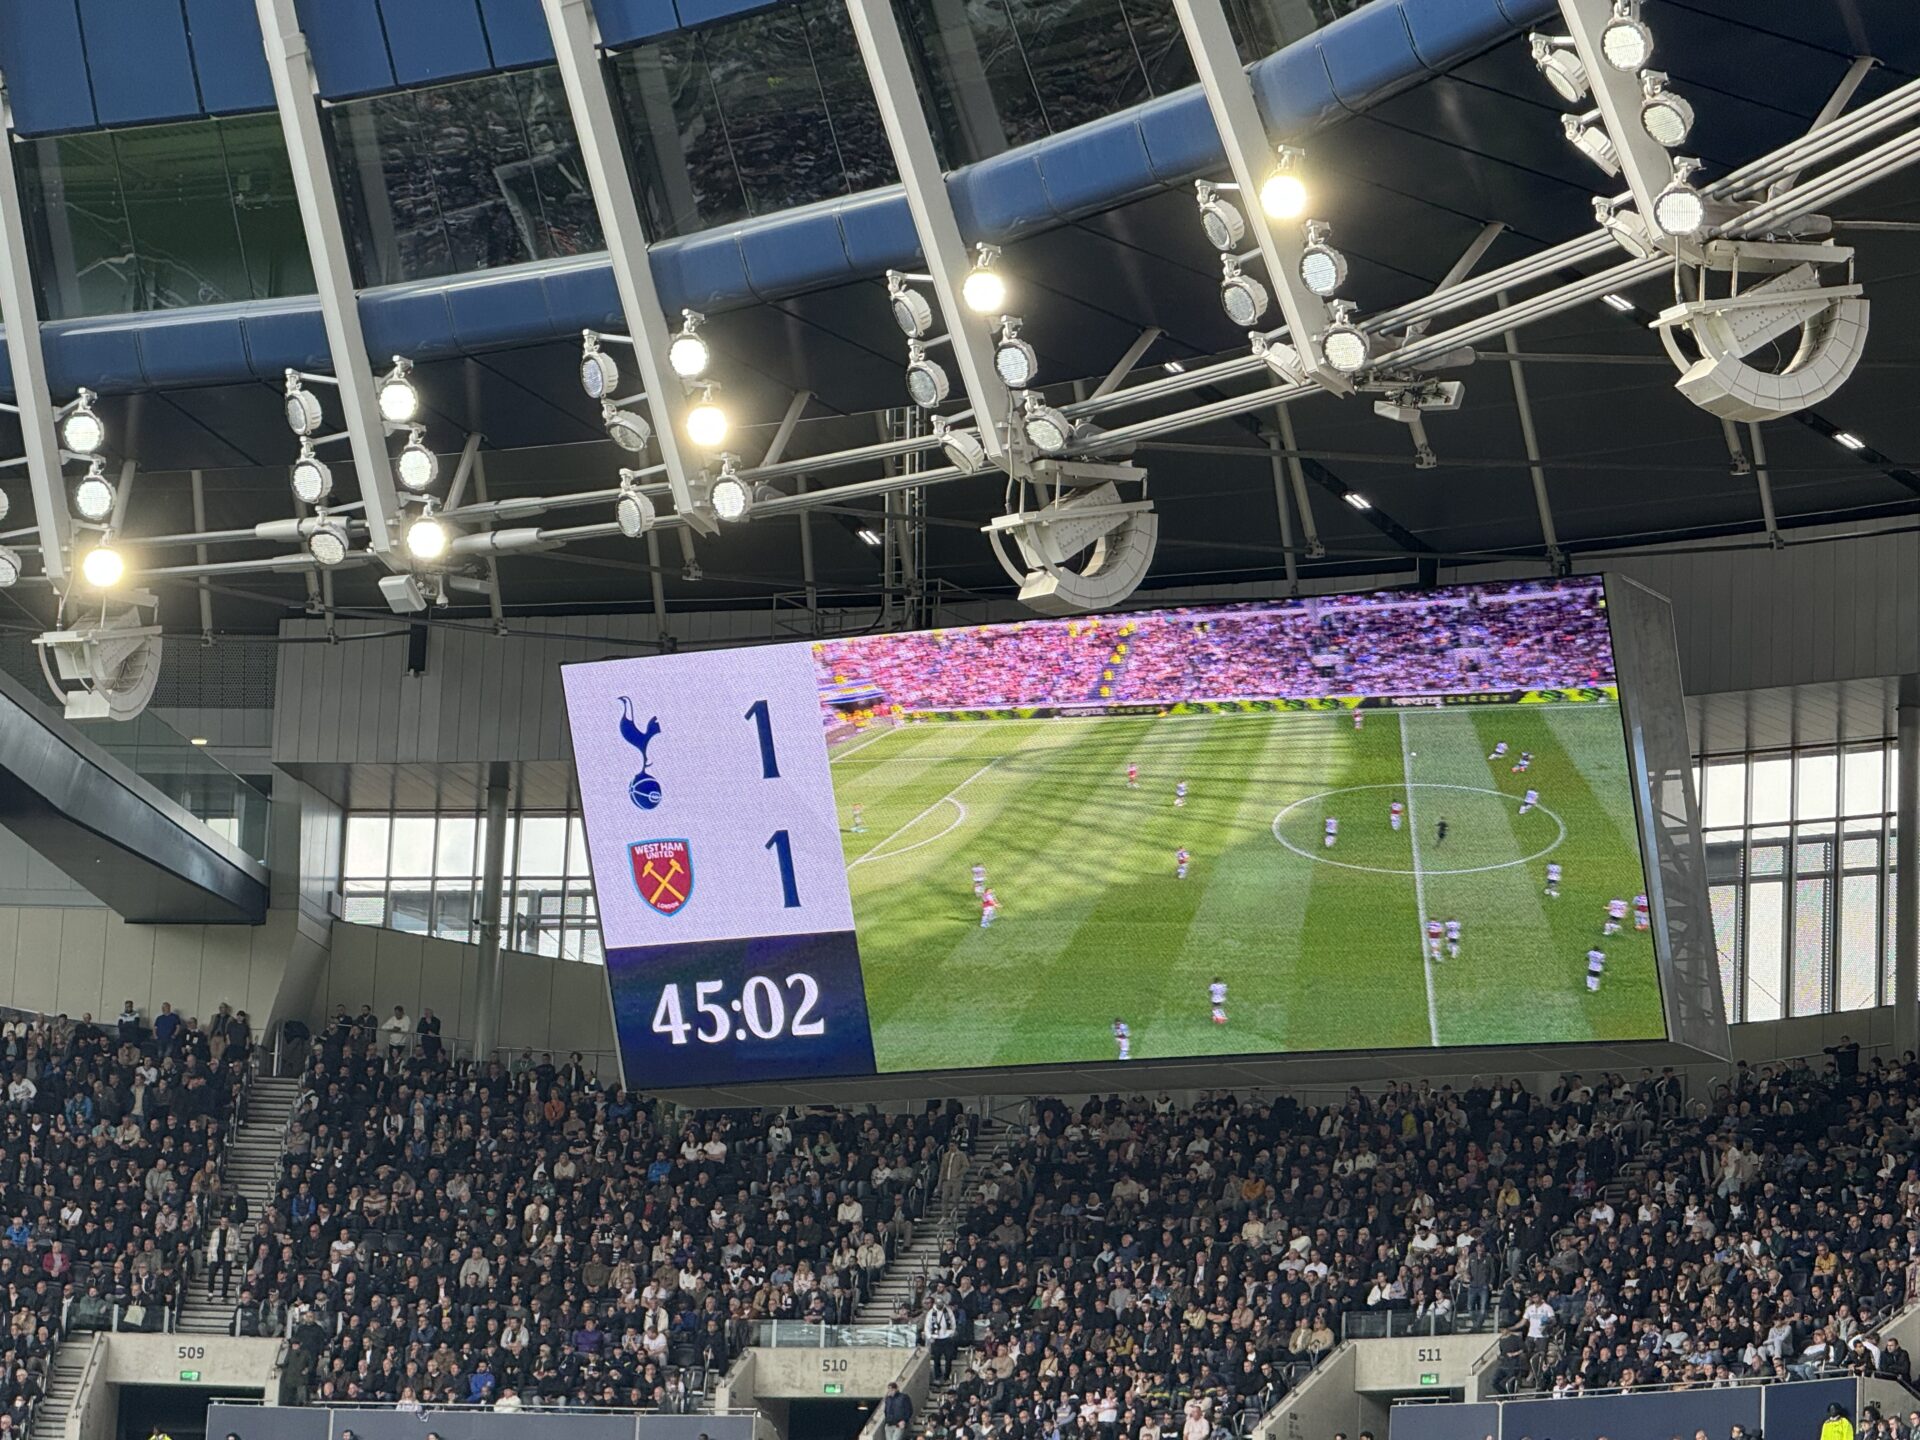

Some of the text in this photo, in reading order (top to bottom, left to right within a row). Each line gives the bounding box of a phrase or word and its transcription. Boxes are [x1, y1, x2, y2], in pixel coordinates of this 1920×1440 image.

[744, 699, 781, 779] 1
[634, 842, 684, 855] WEST HAM
[646, 851, 674, 860] UNITED
[765, 829, 801, 908] 1
[652, 973, 825, 1045] 45:02
[178, 1346, 205, 1359] 509
[1418, 1348, 1442, 1361] 511
[822, 1359, 848, 1372] 510
